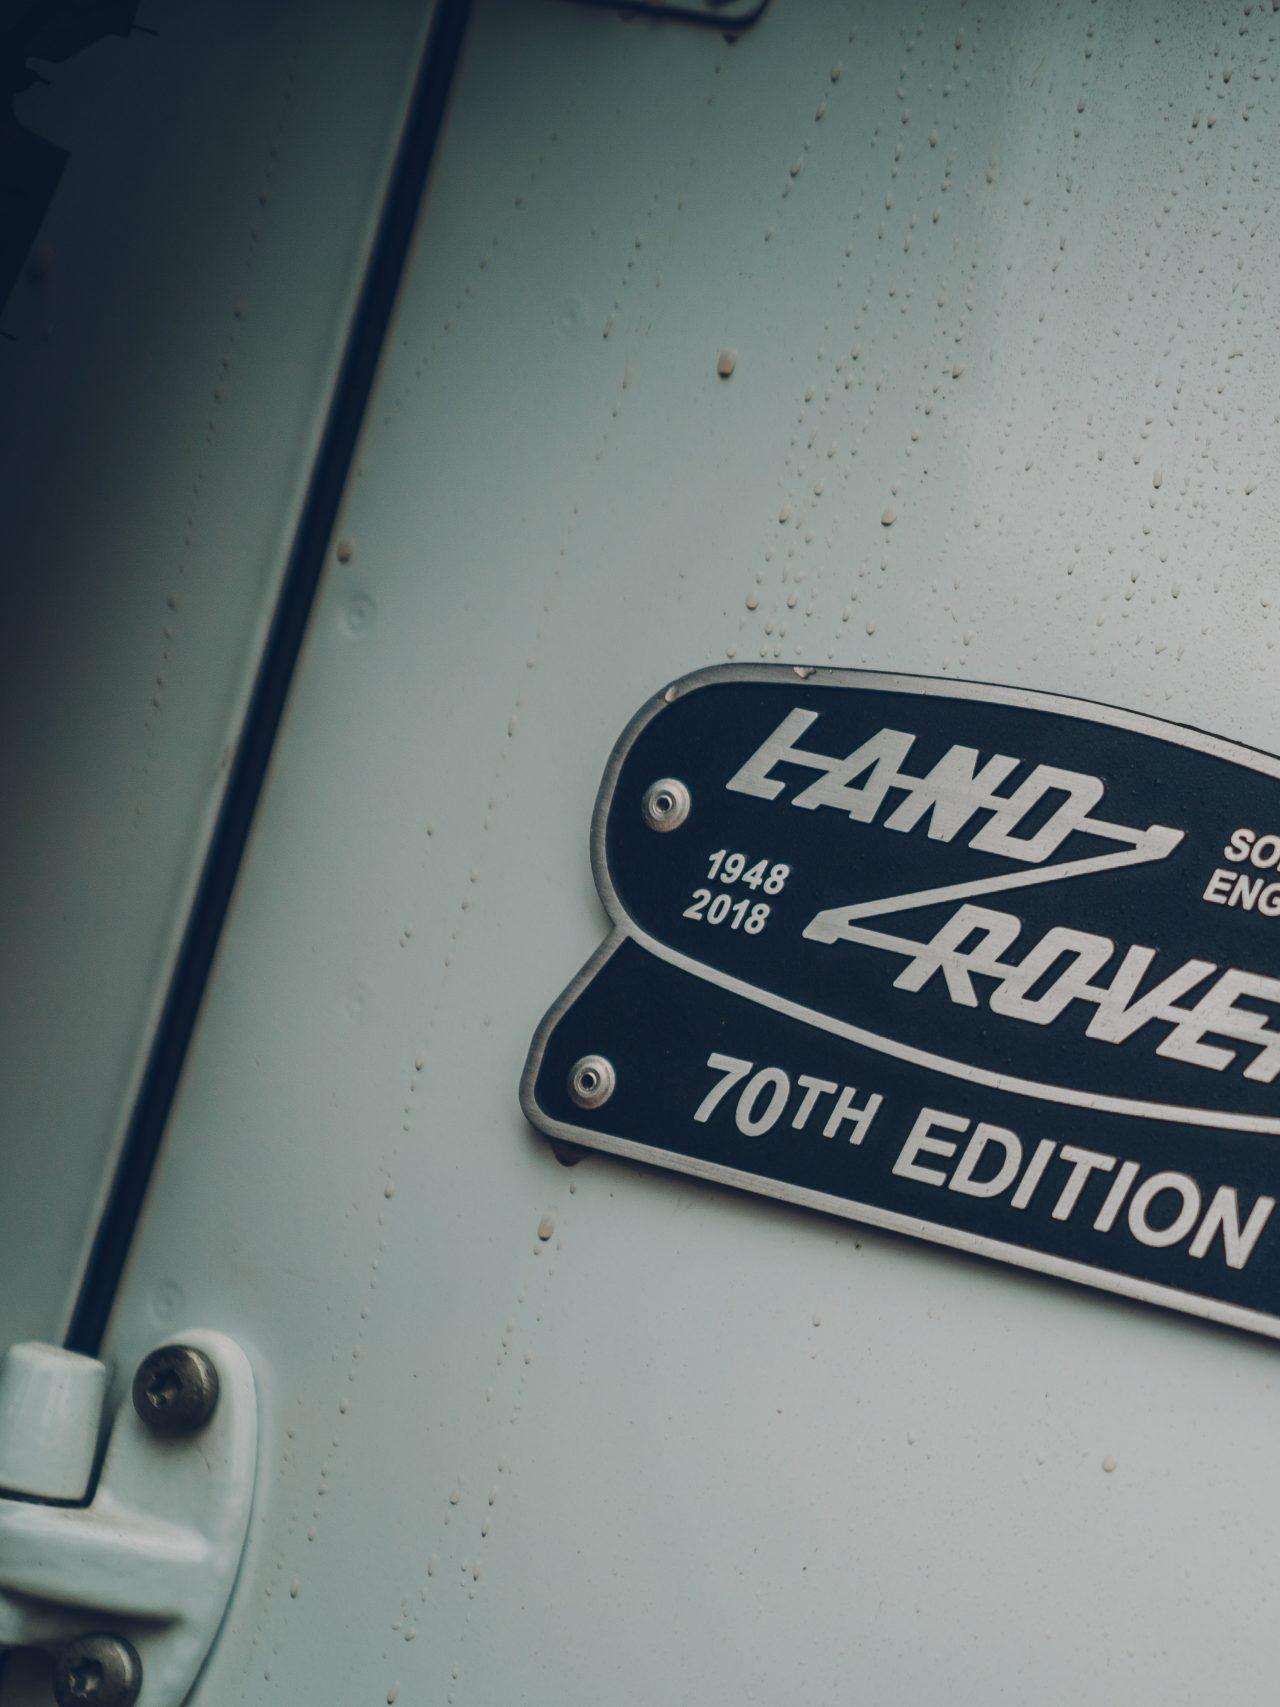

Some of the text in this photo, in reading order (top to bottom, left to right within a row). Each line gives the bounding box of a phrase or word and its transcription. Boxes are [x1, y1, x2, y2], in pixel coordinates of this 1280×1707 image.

[725, 707, 1105, 863] LAND
[682, 888, 771, 935] 2018
[707, 849, 791, 895] 1948
[693, 1052, 1275, 1270] 70TH EDITION
